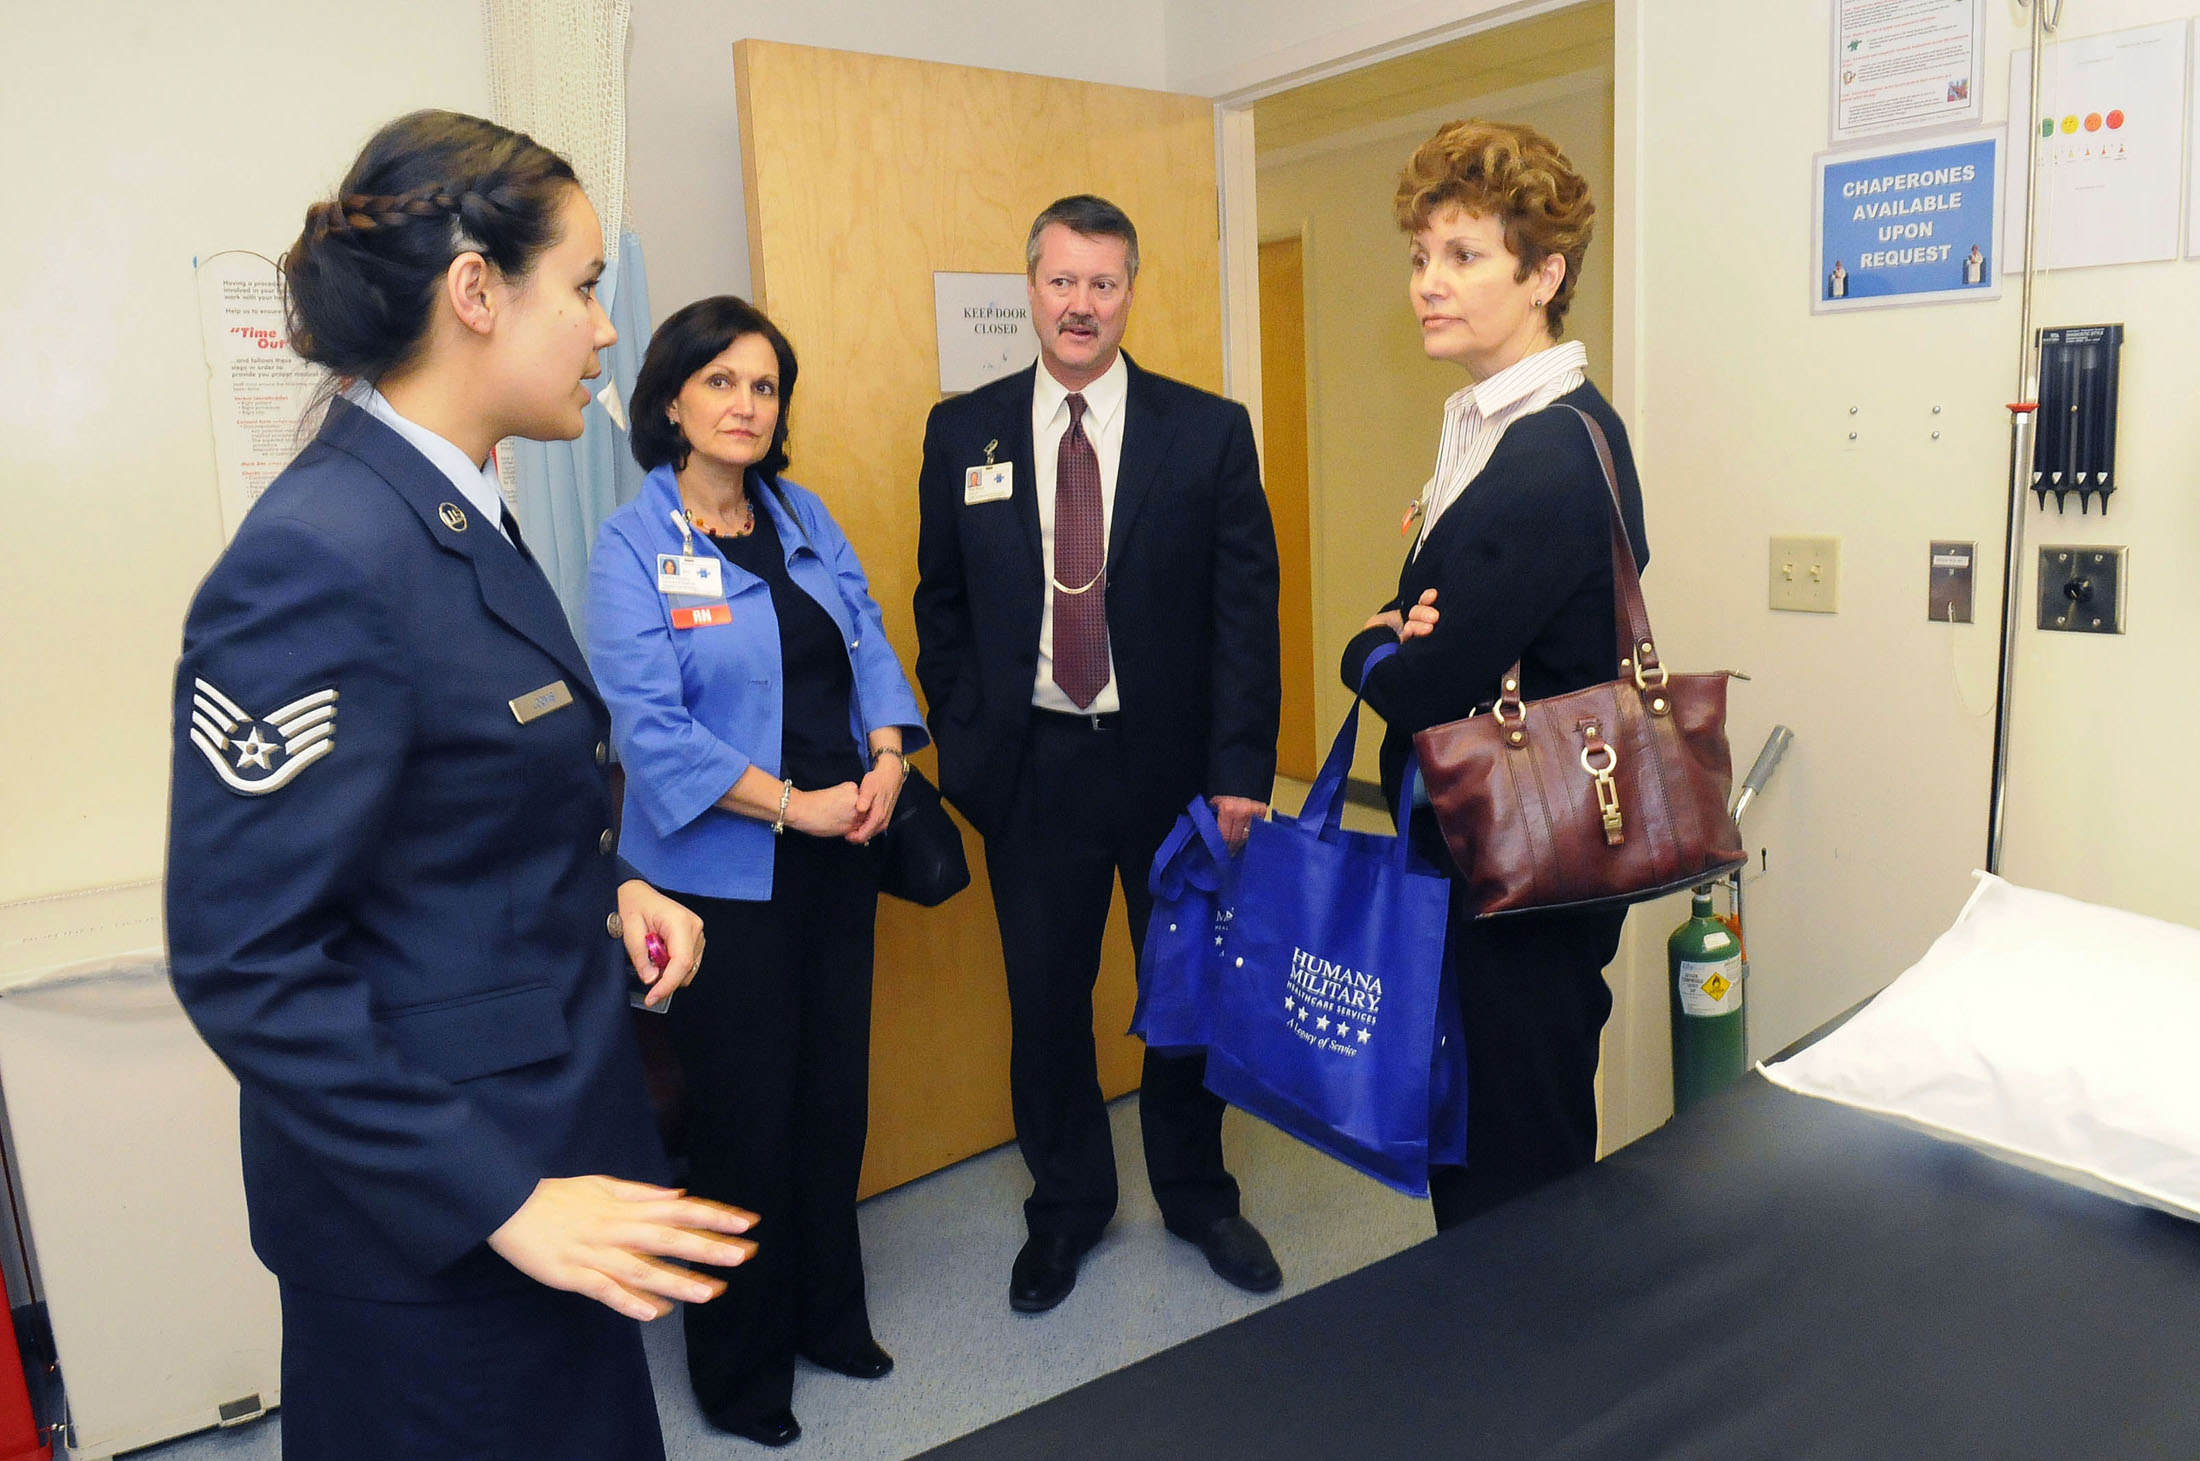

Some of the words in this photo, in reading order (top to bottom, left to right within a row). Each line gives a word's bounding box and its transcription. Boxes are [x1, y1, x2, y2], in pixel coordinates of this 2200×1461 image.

[1842, 165, 1976, 198] CHAPERONES
[1852, 192, 1963, 222] AVAILABLE
[1878, 221, 1934, 241] UPON
[1860, 244, 1952, 269] REQUEST
[963, 307, 993, 318] KEEP
[995, 308, 1027, 318] DOOR
[974, 323, 1018, 334] CLOSED
[692, 608, 713, 624] RN
[1292, 946, 1382, 994] HUMANA
[1286, 980, 1334, 1012] HEALTHCARE
[1336, 1005, 1376, 1026] SERVICES
[1286, 1018, 1295, 1029] A
[1294, 1022, 1317, 1046] Legacy
[1317, 1037, 1330, 1050] of
[1328, 1040, 1358, 1057] Service
